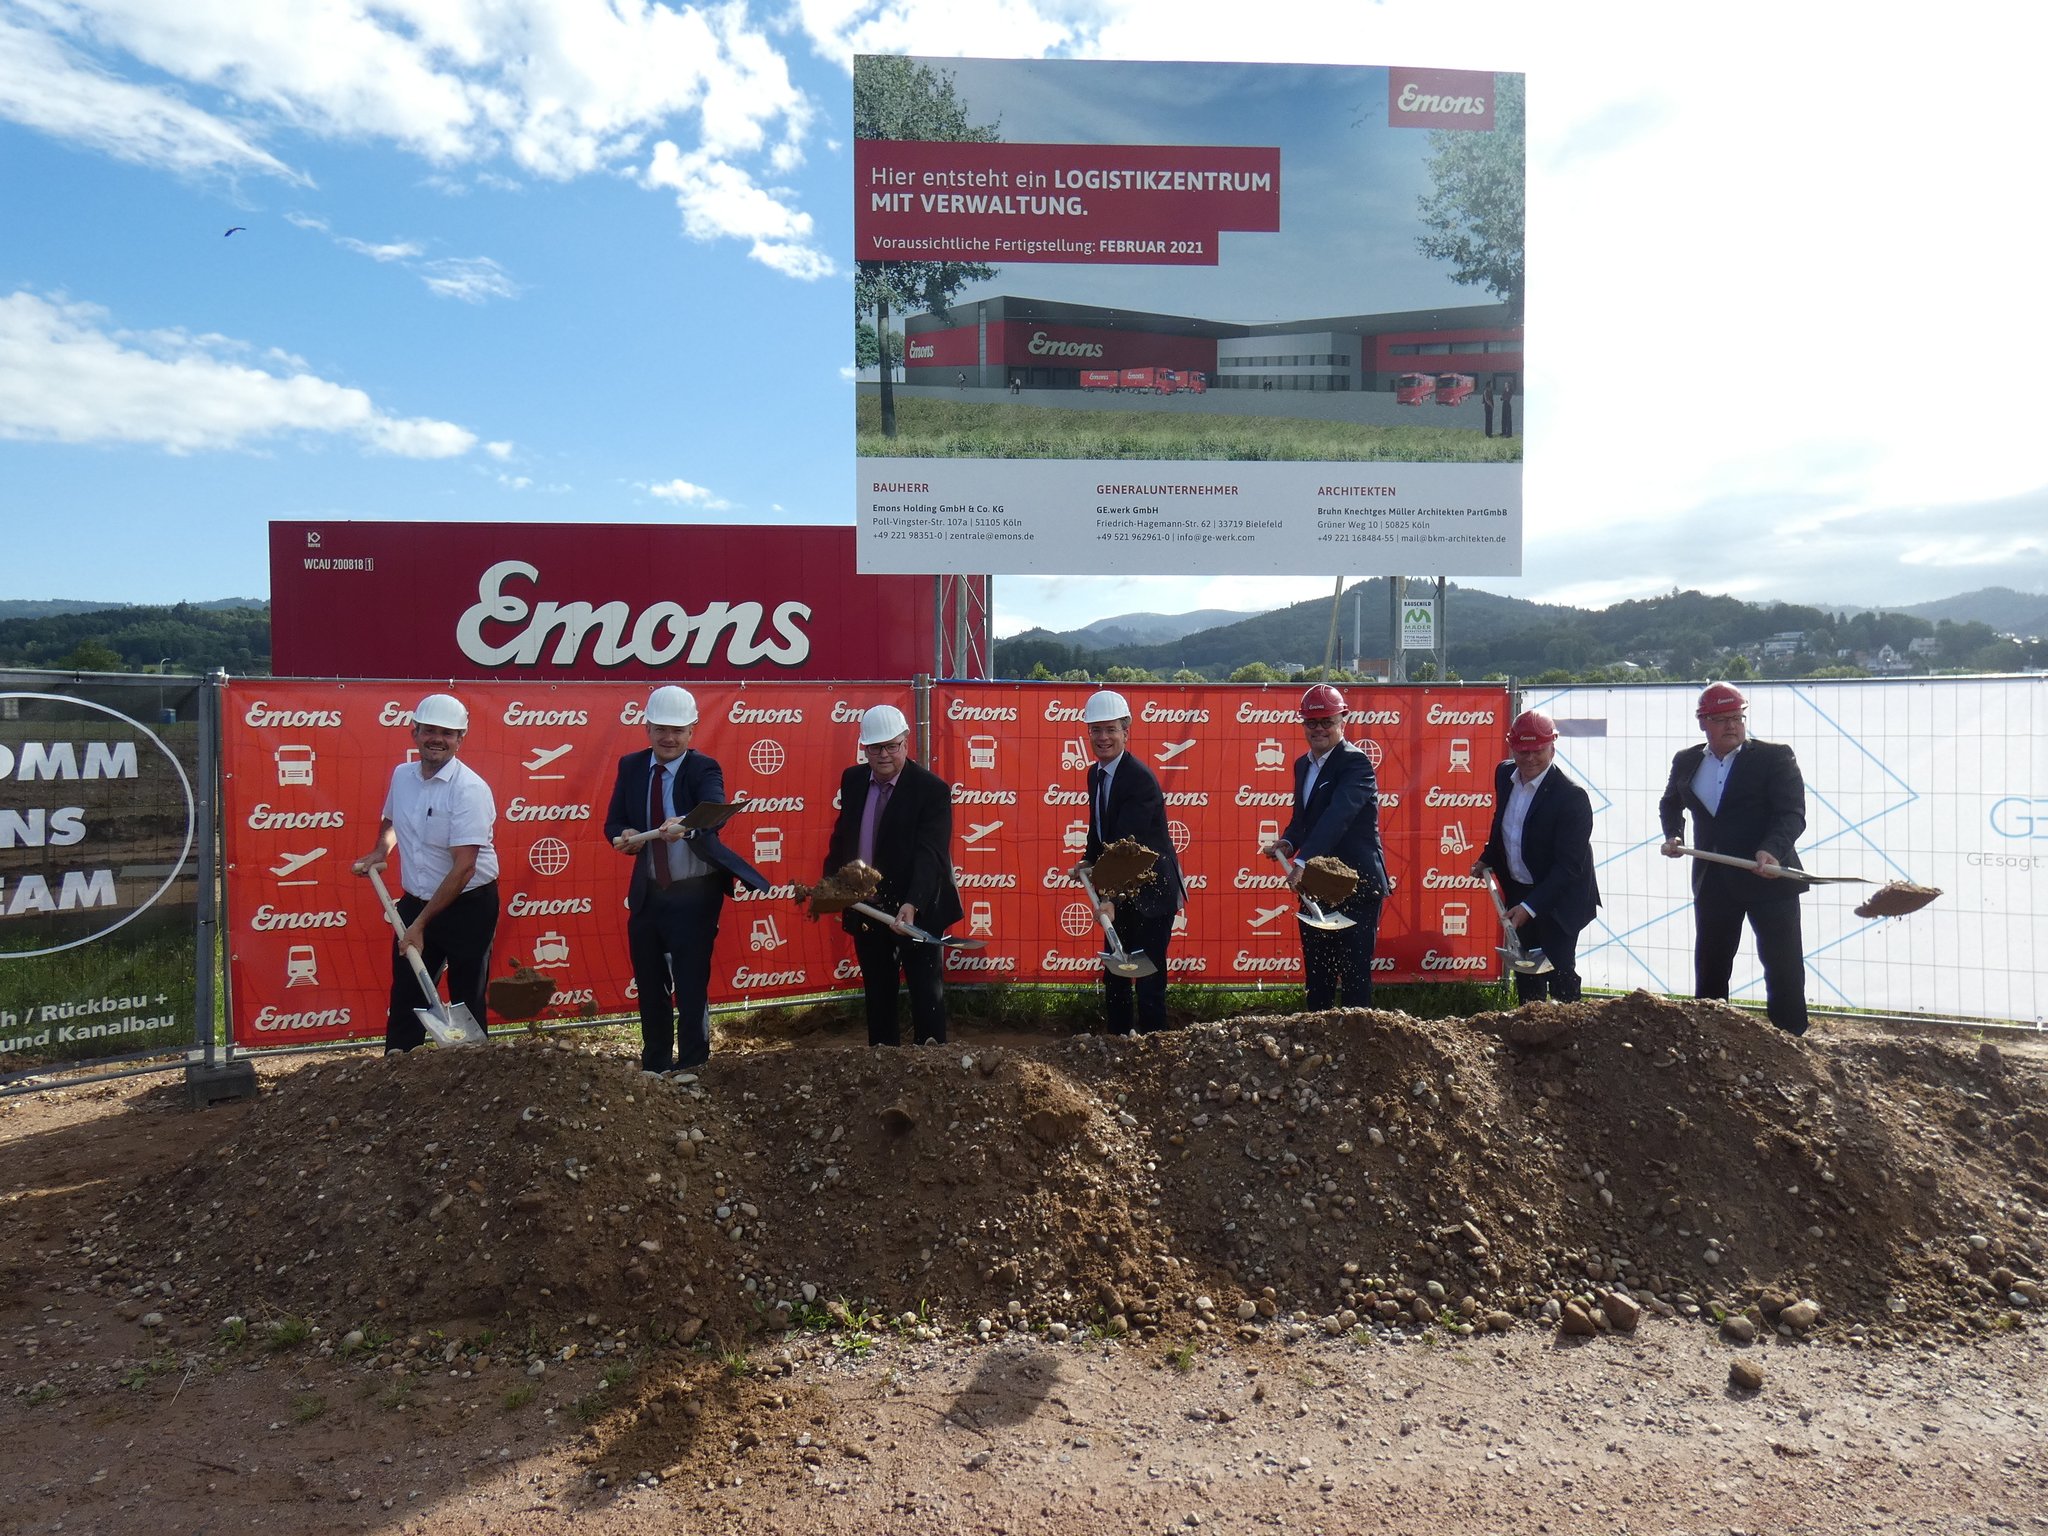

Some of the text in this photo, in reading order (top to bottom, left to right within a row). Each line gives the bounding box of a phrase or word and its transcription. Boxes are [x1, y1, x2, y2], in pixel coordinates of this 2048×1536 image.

[1397, 84, 1485, 114] Emons
[872, 167, 1270, 192] Hier entsteht ein LOGISTIKZENTRUM
[871, 193, 1088, 216] MIT VERWALTUNG.
[873, 236, 1203, 254] Voraussichtliche Fertigstellung: FEBRUAR 2021
[909, 340, 934, 358] Emons
[1028, 331, 1103, 358] Emons
[873, 483, 929, 492] BAUHERR
[1096, 485, 1239, 495] GENERALUNTERNEHMER
[1318, 487, 1396, 496] ARCHITEKTEN
[903, 505, 937, 514] Holding
[977, 505, 990, 513] Co.
[1344, 508, 1386, 517] Knechtges
[1389, 508, 1415, 516] Müller
[873, 518, 945, 527] Poll-Vingster-Str.
[1003, 519, 1022, 527] Köln
[1097, 520, 1199, 529] Friedrich-Hagemann-Str.
[1318, 521, 1345, 529] Grüner
[1348, 522, 1365, 530] Weg
[950, 532, 1034, 540] zentrale@emons.de
[1177, 534, 1255, 543] info@ge-werk.com
[1401, 535, 1506, 543] mail@bkm-architekten.de
[304, 559, 331, 569] WCAU
[333, 559, 363, 569] 200818
[456, 560, 812, 667] Emons
[246, 701, 342, 728] Emons
[503, 702, 588, 727] Emons
[728, 701, 803, 724] Emons
[947, 699, 1017, 721] Emons
[1141, 701, 1209, 723] Emons
[1344, 711, 1400, 724] mons
[1426, 703, 1494, 725] Emons
[951, 782, 1016, 804] Emons
[1044, 784, 1089, 805] Emo
[1235, 785, 1294, 806] Emon
[1425, 786, 1492, 807] Emons
[248, 803, 344, 830] Emons
[506, 797, 590, 822] Emons
[0, 869, 117, 915] AM
[508, 893, 592, 917] Emons
[252, 904, 347, 931] Emons
[946, 949, 1015, 971] Emons
[1042, 950, 1101, 971] Emon
[1233, 950, 1300, 971] Emons
[1421, 949, 1487, 970] Emons
[732, 966, 806, 990] Emons
[550, 988, 593, 1006] ons
[41, 995, 147, 1022] Rückbau
[255, 1006, 351, 1032] Emons
[58, 1015, 174, 1043] Kanalbau
